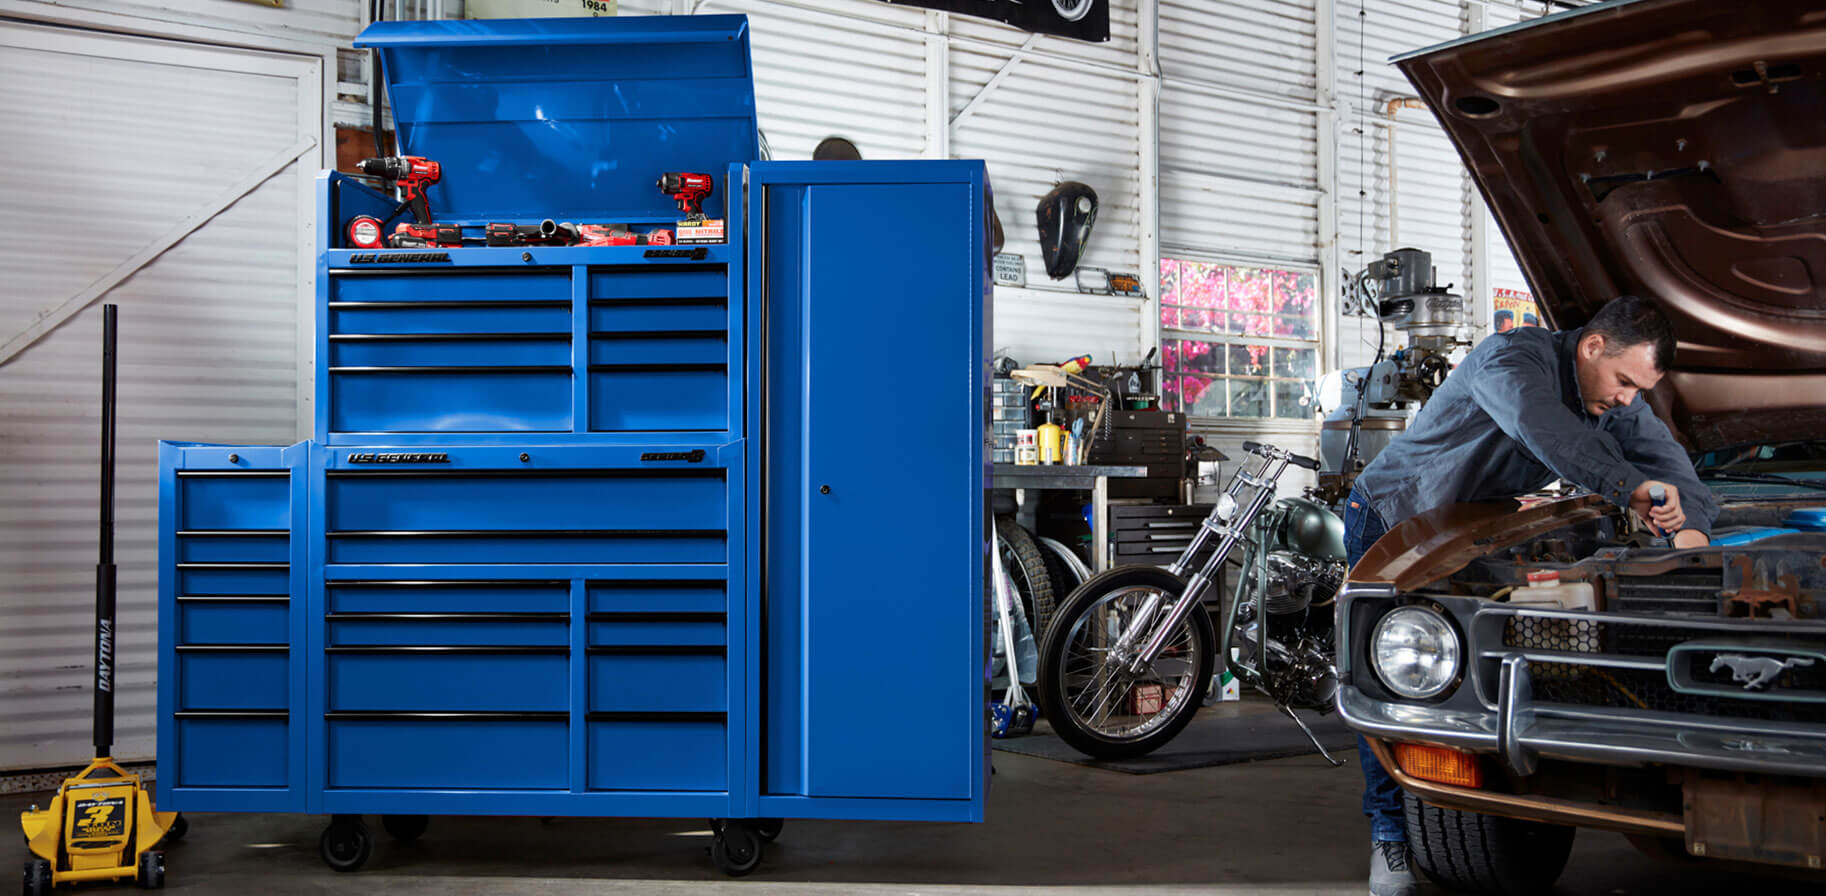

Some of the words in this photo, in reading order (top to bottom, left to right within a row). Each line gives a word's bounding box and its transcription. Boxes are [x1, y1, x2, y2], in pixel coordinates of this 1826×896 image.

[582, 0, 607, 12] 1984
[377, 252, 453, 263] GENERAL
[1000, 273, 1018, 282] LEAD
[99, 618, 112, 692] DAYTONA
[77, 805, 114, 827] 3
